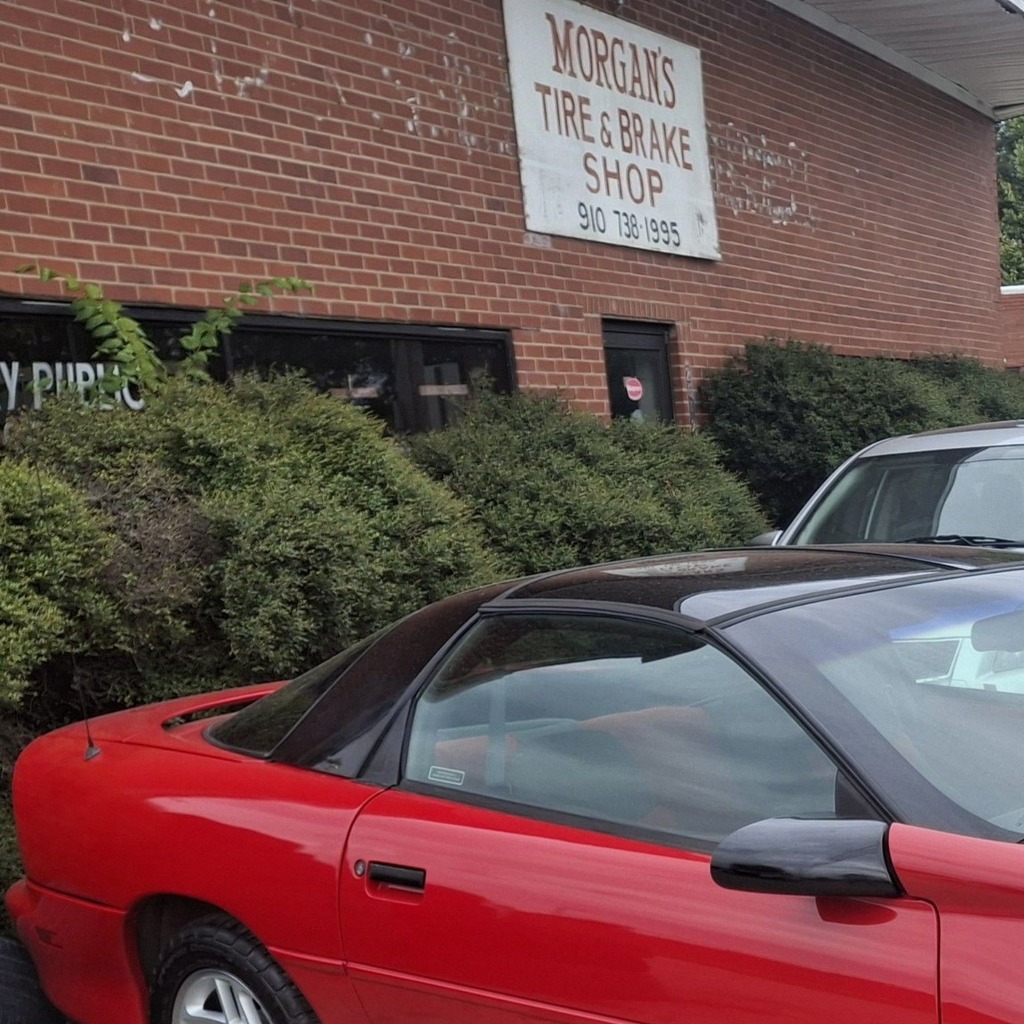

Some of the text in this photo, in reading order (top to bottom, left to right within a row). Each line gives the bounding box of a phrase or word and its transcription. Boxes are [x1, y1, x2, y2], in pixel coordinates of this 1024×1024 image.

[545, 12, 676, 109] MORGAN'S
[534, 82, 693, 171] TIRE & BRAKE
[583, 153, 663, 207] SHOP
[578, 203, 606, 234] 910
